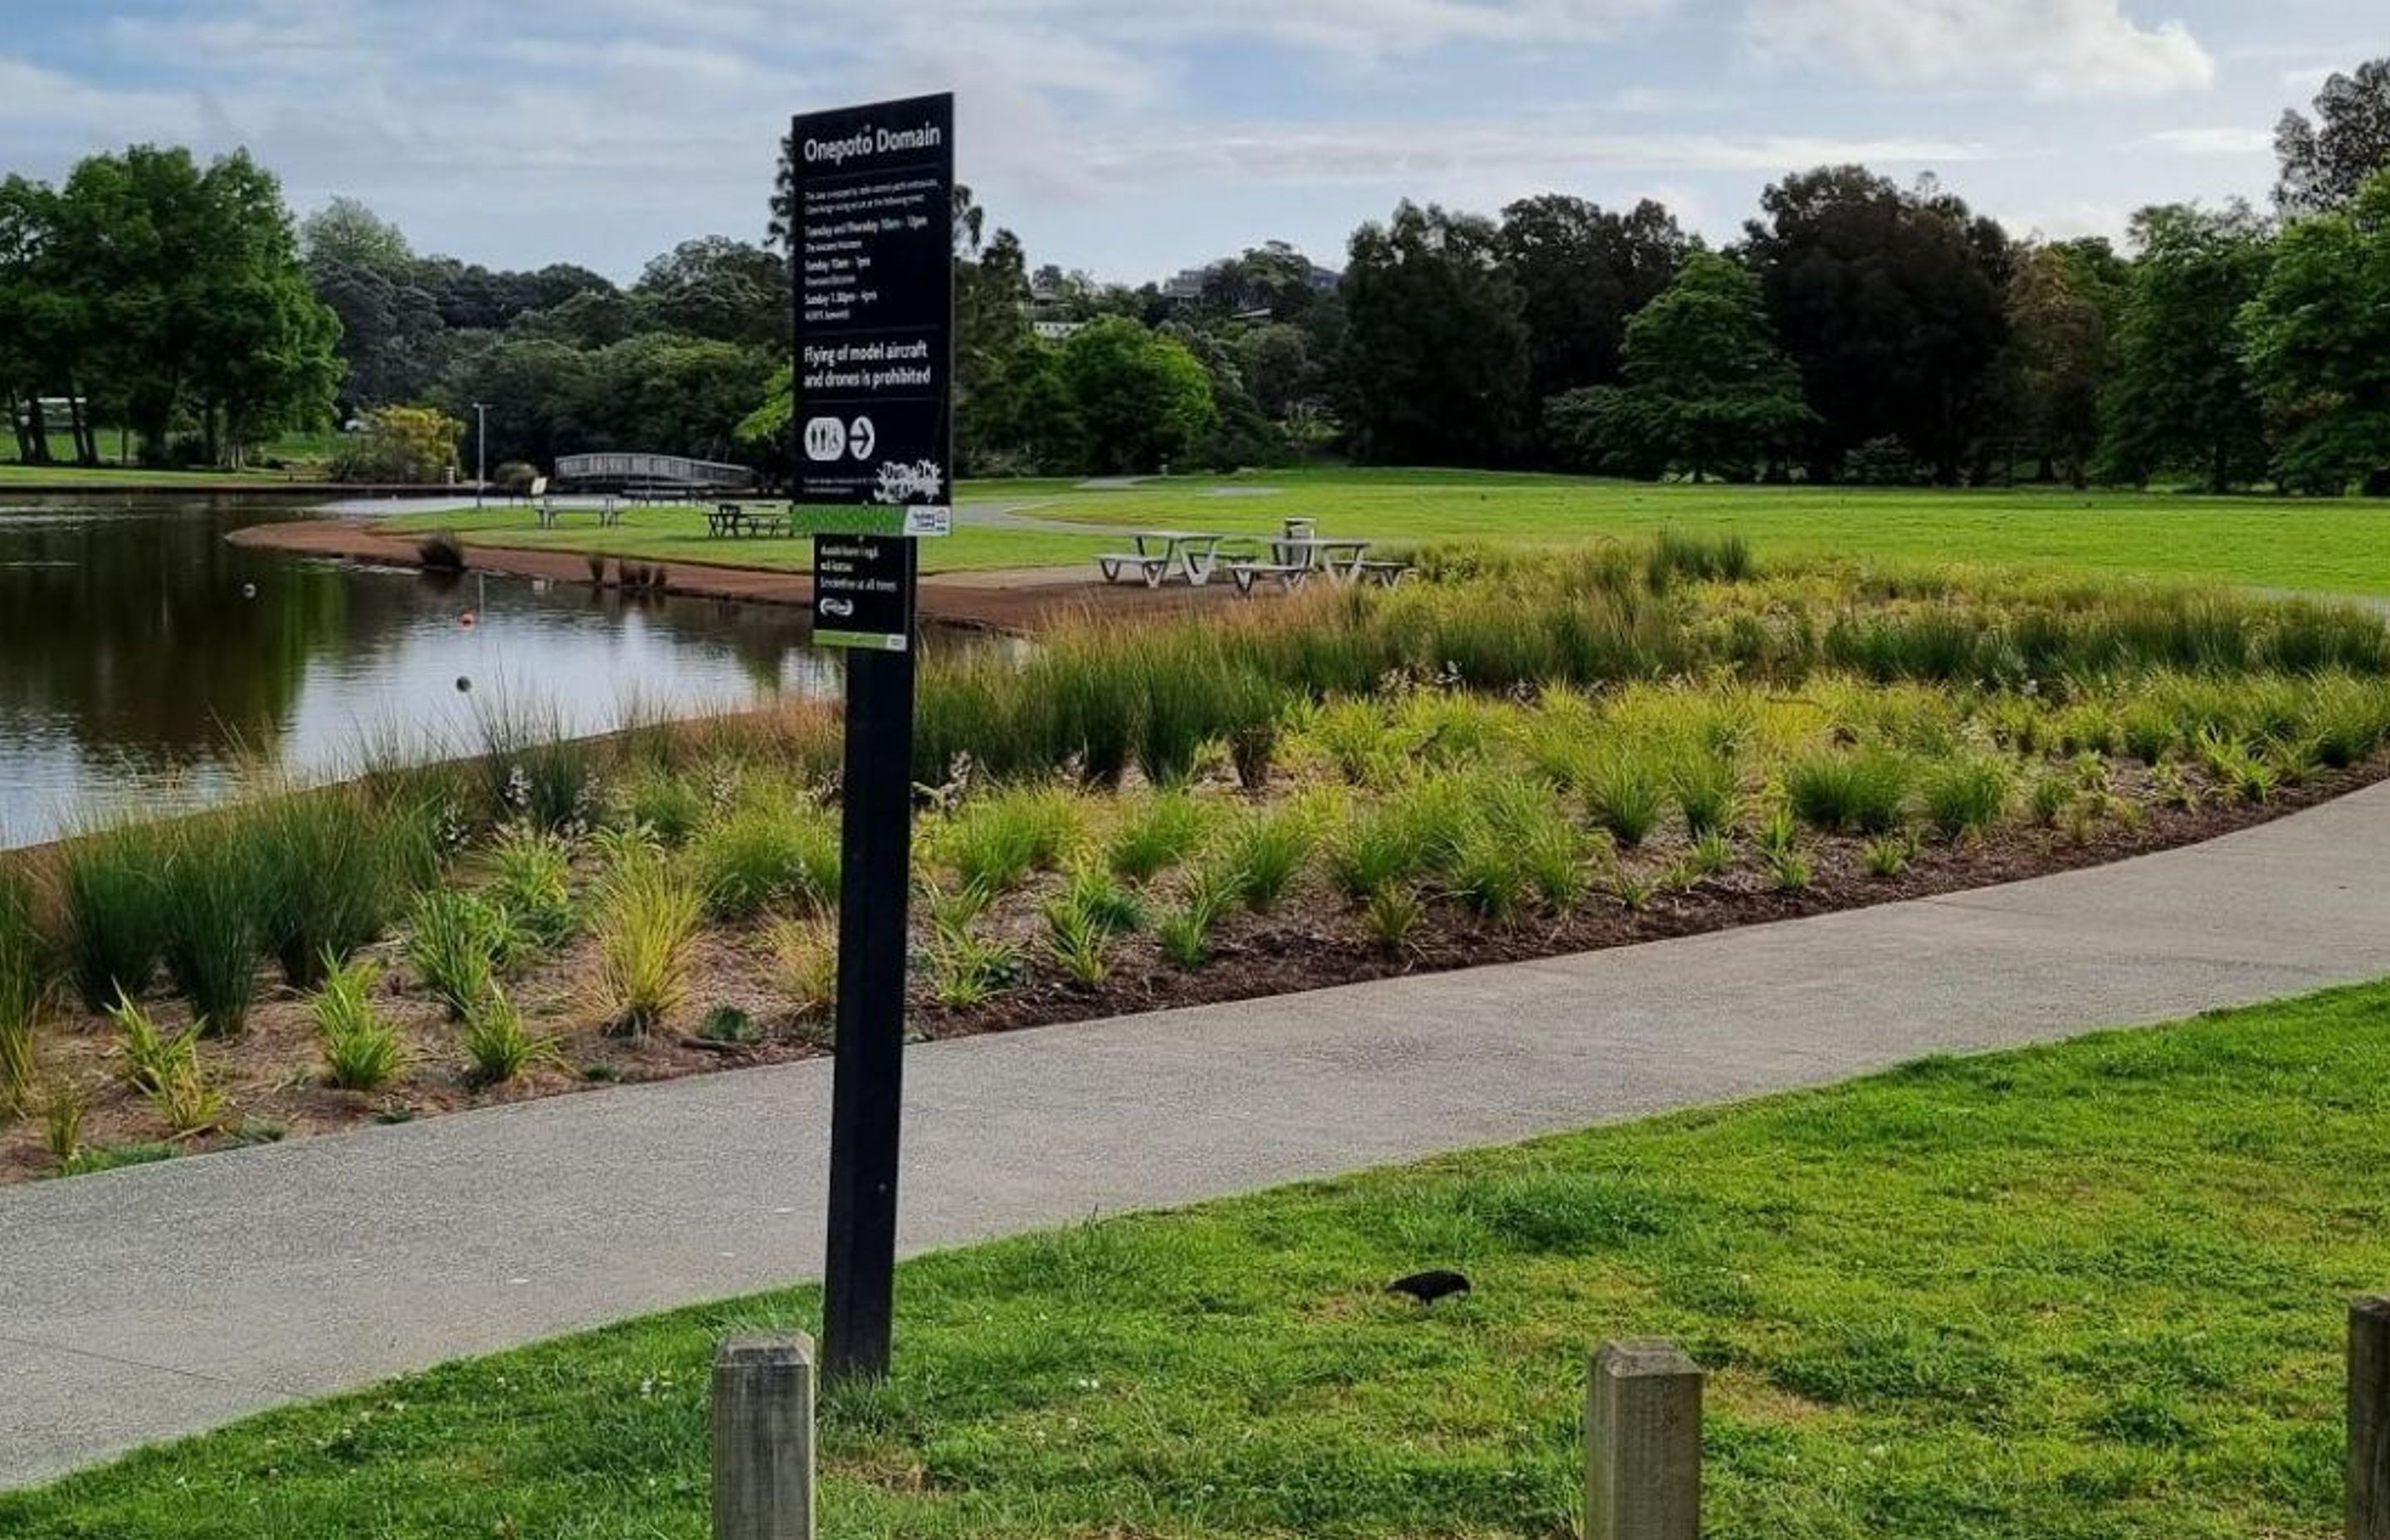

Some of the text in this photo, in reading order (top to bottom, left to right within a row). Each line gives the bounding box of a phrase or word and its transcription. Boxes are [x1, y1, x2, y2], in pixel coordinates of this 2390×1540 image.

[804, 121, 940, 166] Onepoto Domain
[805, 293, 829, 307] Sunday
[804, 339, 928, 368] Flying of model aircraft
[804, 365, 931, 390] and drones is prohibited
